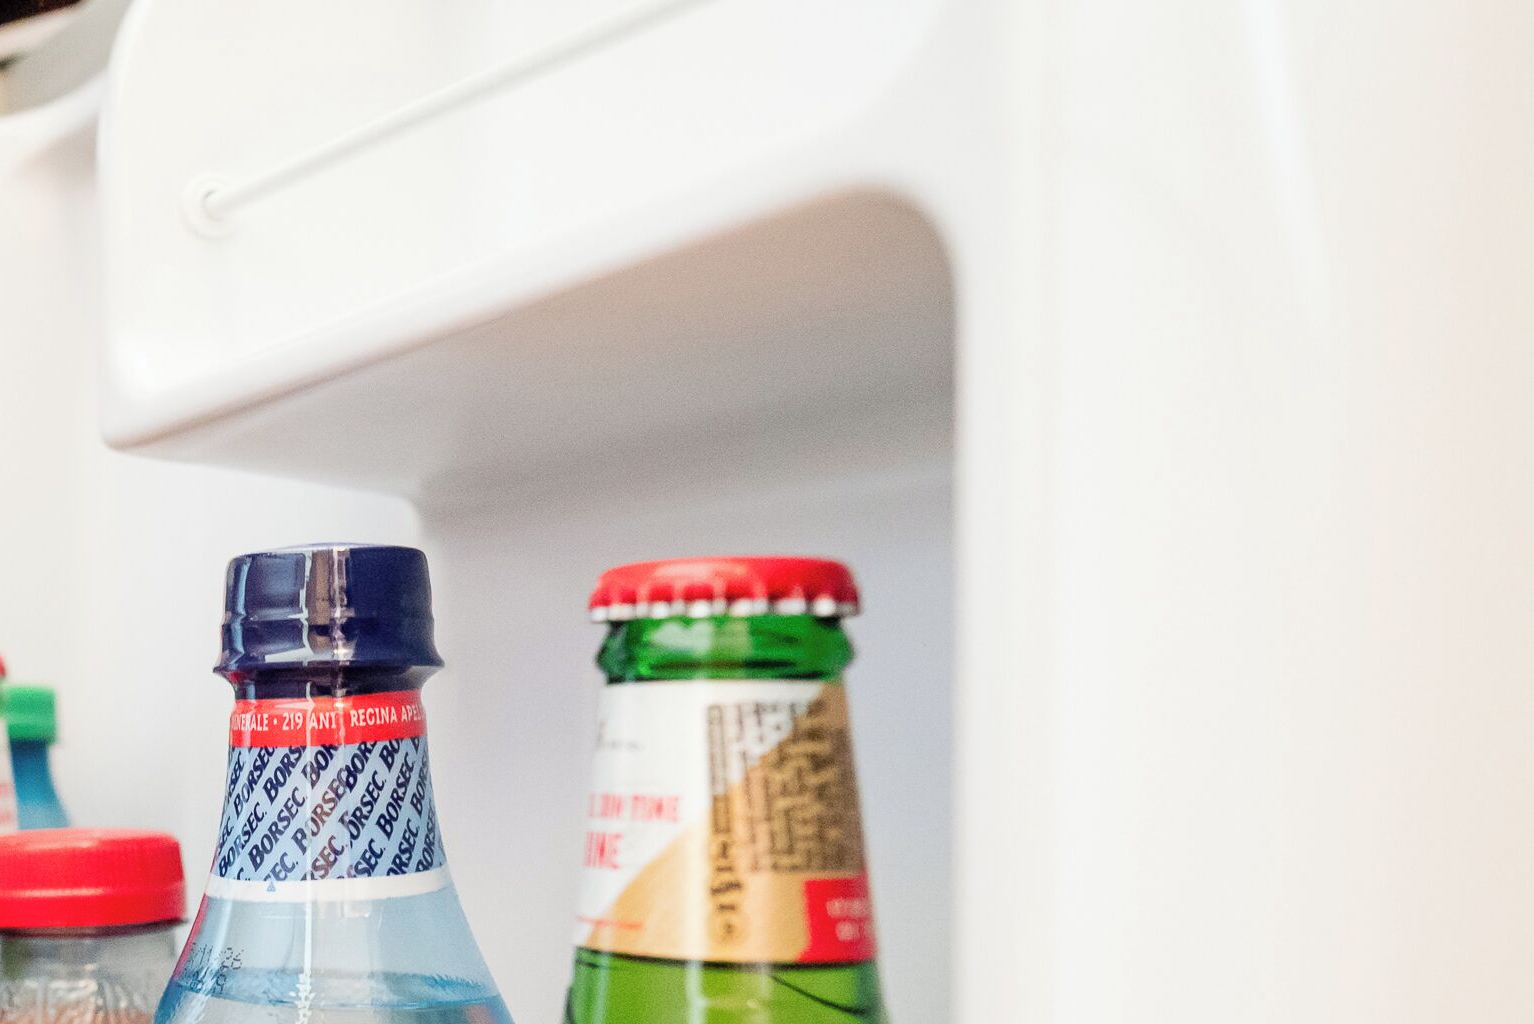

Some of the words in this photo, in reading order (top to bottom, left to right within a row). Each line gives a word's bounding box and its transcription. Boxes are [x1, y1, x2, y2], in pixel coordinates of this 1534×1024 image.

[282, 713, 303, 730] 219
[310, 711, 337, 730] ANI
[350, 706, 397, 727] REGINA
